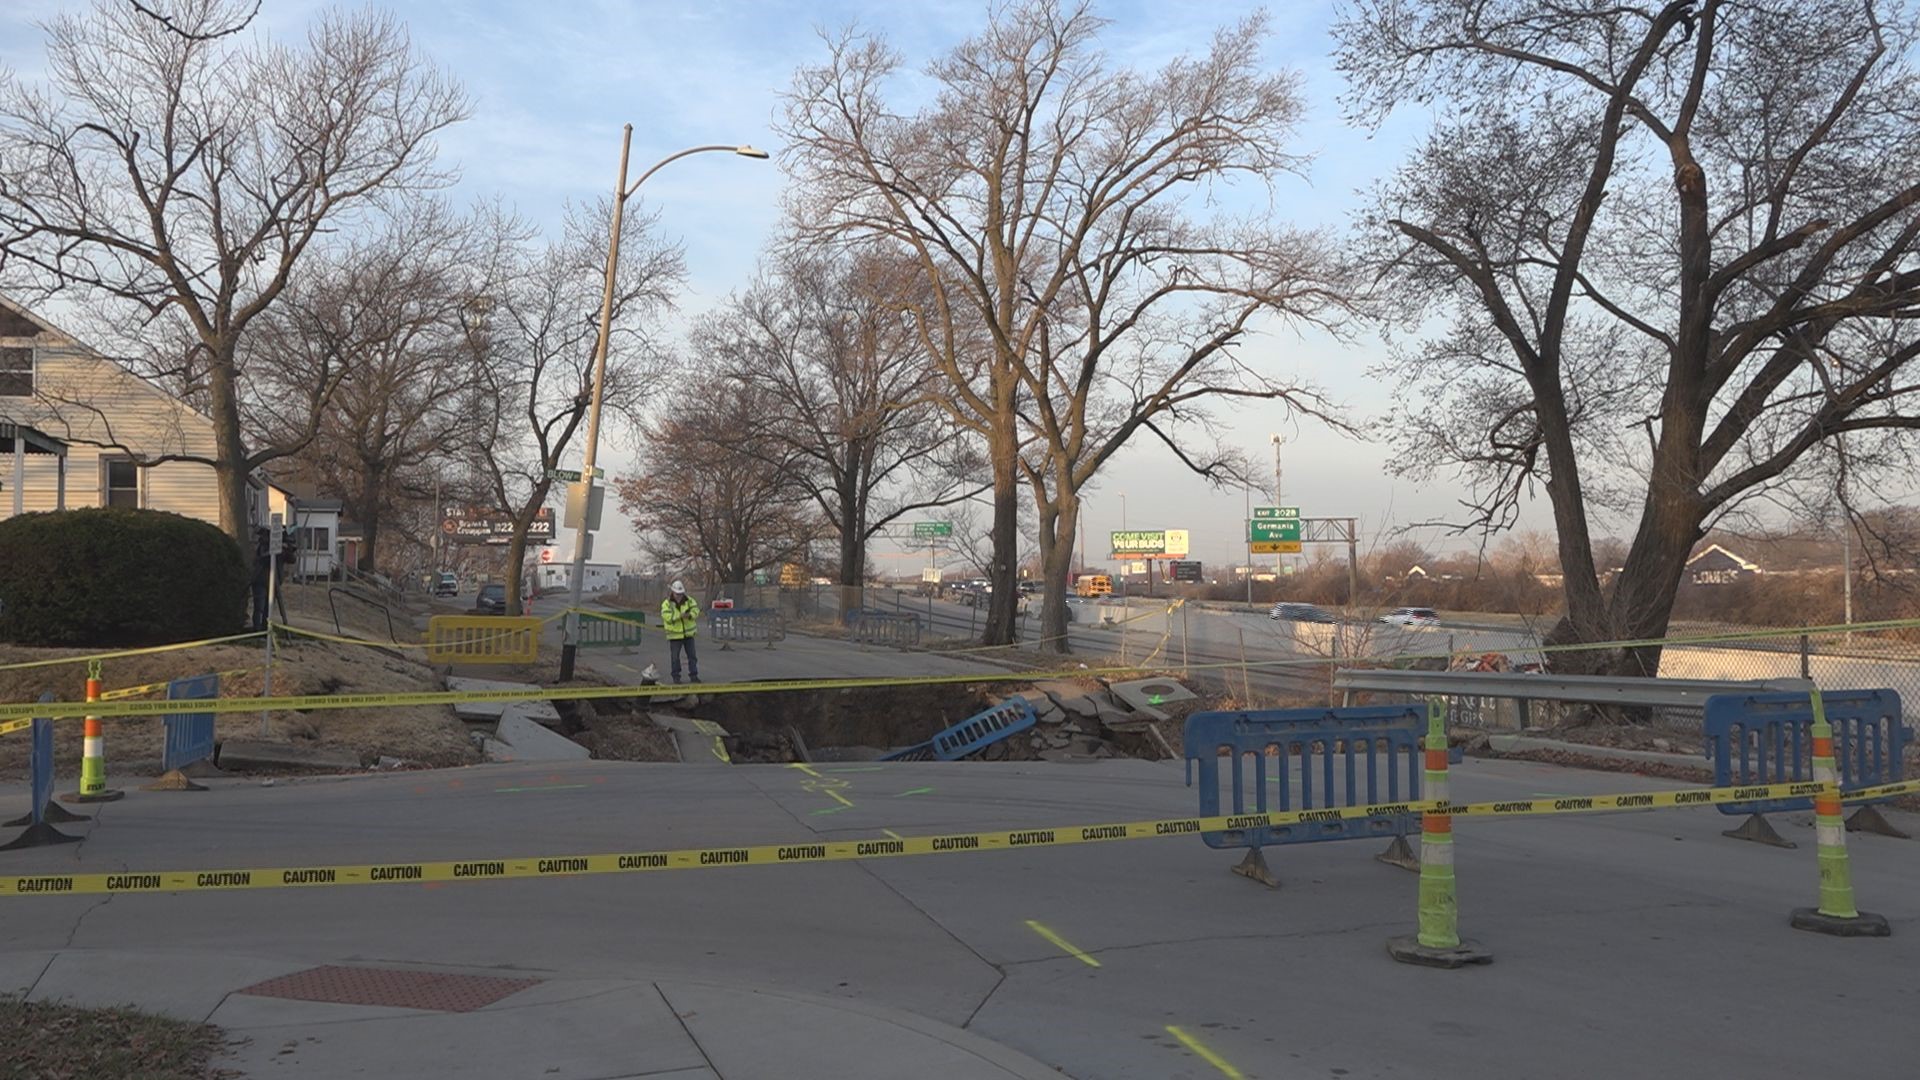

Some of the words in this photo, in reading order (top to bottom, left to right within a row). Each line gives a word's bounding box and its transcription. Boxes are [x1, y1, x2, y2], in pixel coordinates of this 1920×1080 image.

[547, 470, 574, 480] BLOW
[1112, 532, 1140, 541] COME
[1140, 532, 1165, 541] VISIT
[1112, 540, 1138, 549] YOUR
[1138, 540, 1164, 549] BUDS
[1692, 570, 1738, 584] LOWE'S
[1493, 802, 1532, 812] CAUTION
[1554, 799, 1592, 809] CAUTION
[1616, 795, 1653, 807] CAUTION
[1675, 792, 1711, 803] CAUTION
[1734, 788, 1769, 800] CAUTION
[1790, 784, 1824, 795] CAUTION
[17, 878, 73, 892] CAUTION
[106, 876, 161, 889] CAUTION
[197, 872, 250, 886] CAUTION
[283, 870, 336, 883] CAUTION
[370, 866, 422, 880] CAUTION
[453, 863, 505, 877] CAUTION
[538, 859, 588, 872] CAUTION
[618, 855, 667, 868] CAUTION
[700, 850, 748, 864] CAUTION
[778, 846, 825, 860] CAUTION
[857, 841, 904, 855] CAUTION
[932, 836, 978, 850] CAUTION
[1009, 831, 1055, 845] CAUTION
[1082, 826, 1126, 840] CAUTION
[1156, 820, 1200, 834] CAUTION
[1226, 815, 1270, 828] CAUTION
[1298, 810, 1342, 823] CAUTION
